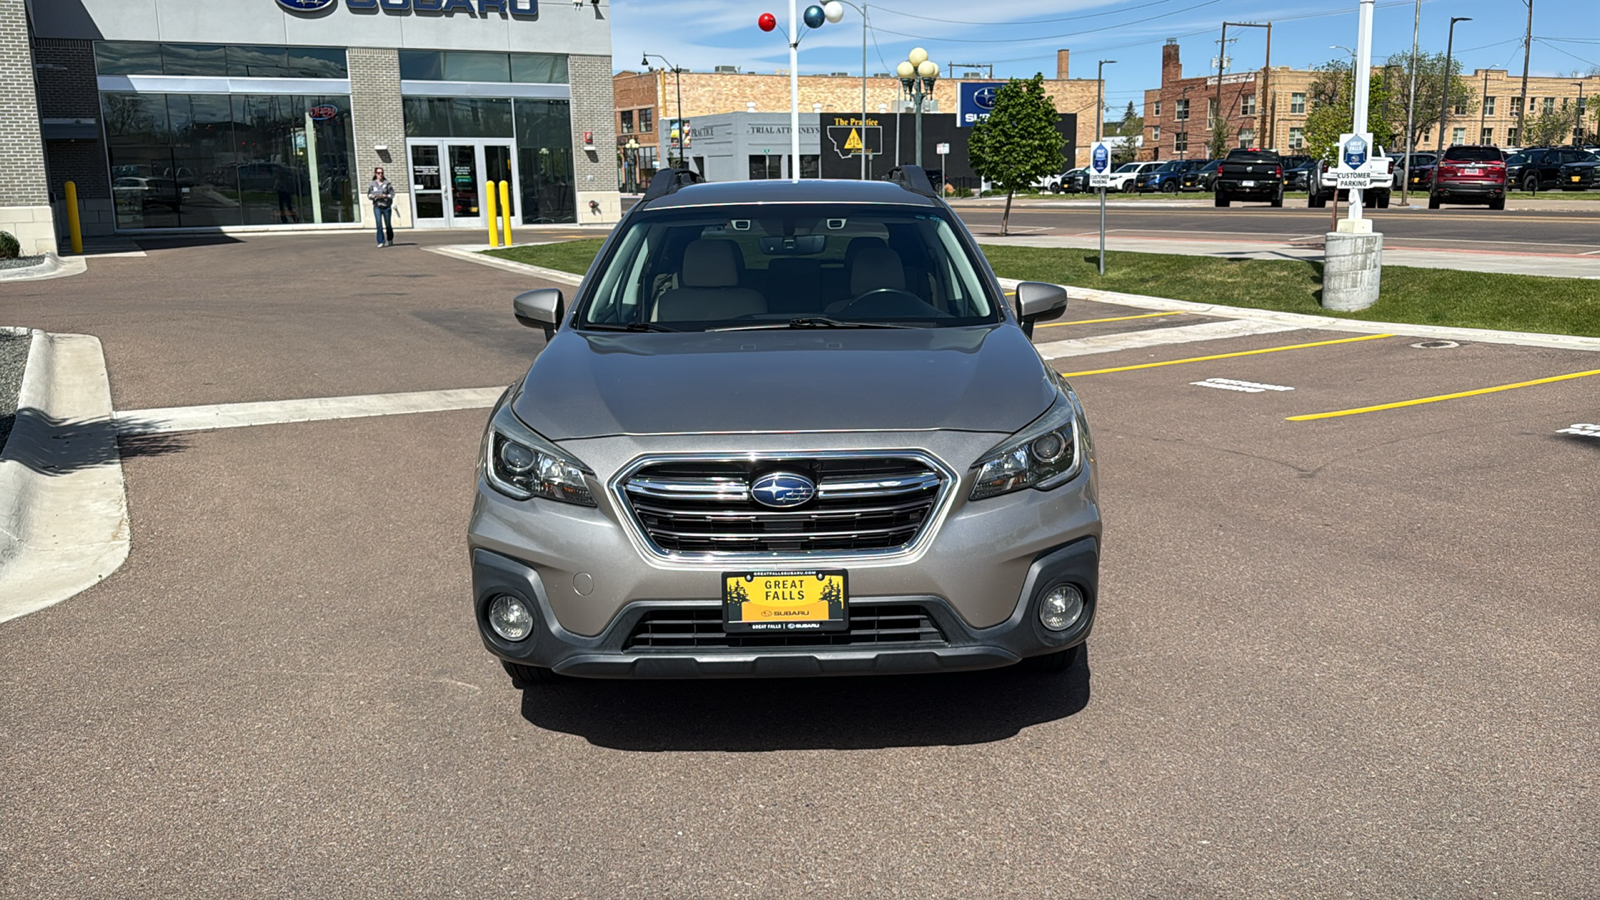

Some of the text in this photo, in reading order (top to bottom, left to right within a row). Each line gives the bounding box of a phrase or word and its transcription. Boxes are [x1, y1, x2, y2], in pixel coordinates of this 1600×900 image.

[309, 106, 335, 117] OPEN
[834, 118, 878, 126] The Pratice
[765, 580, 805, 589] GREAT
[765, 591, 805, 600] FALLS
